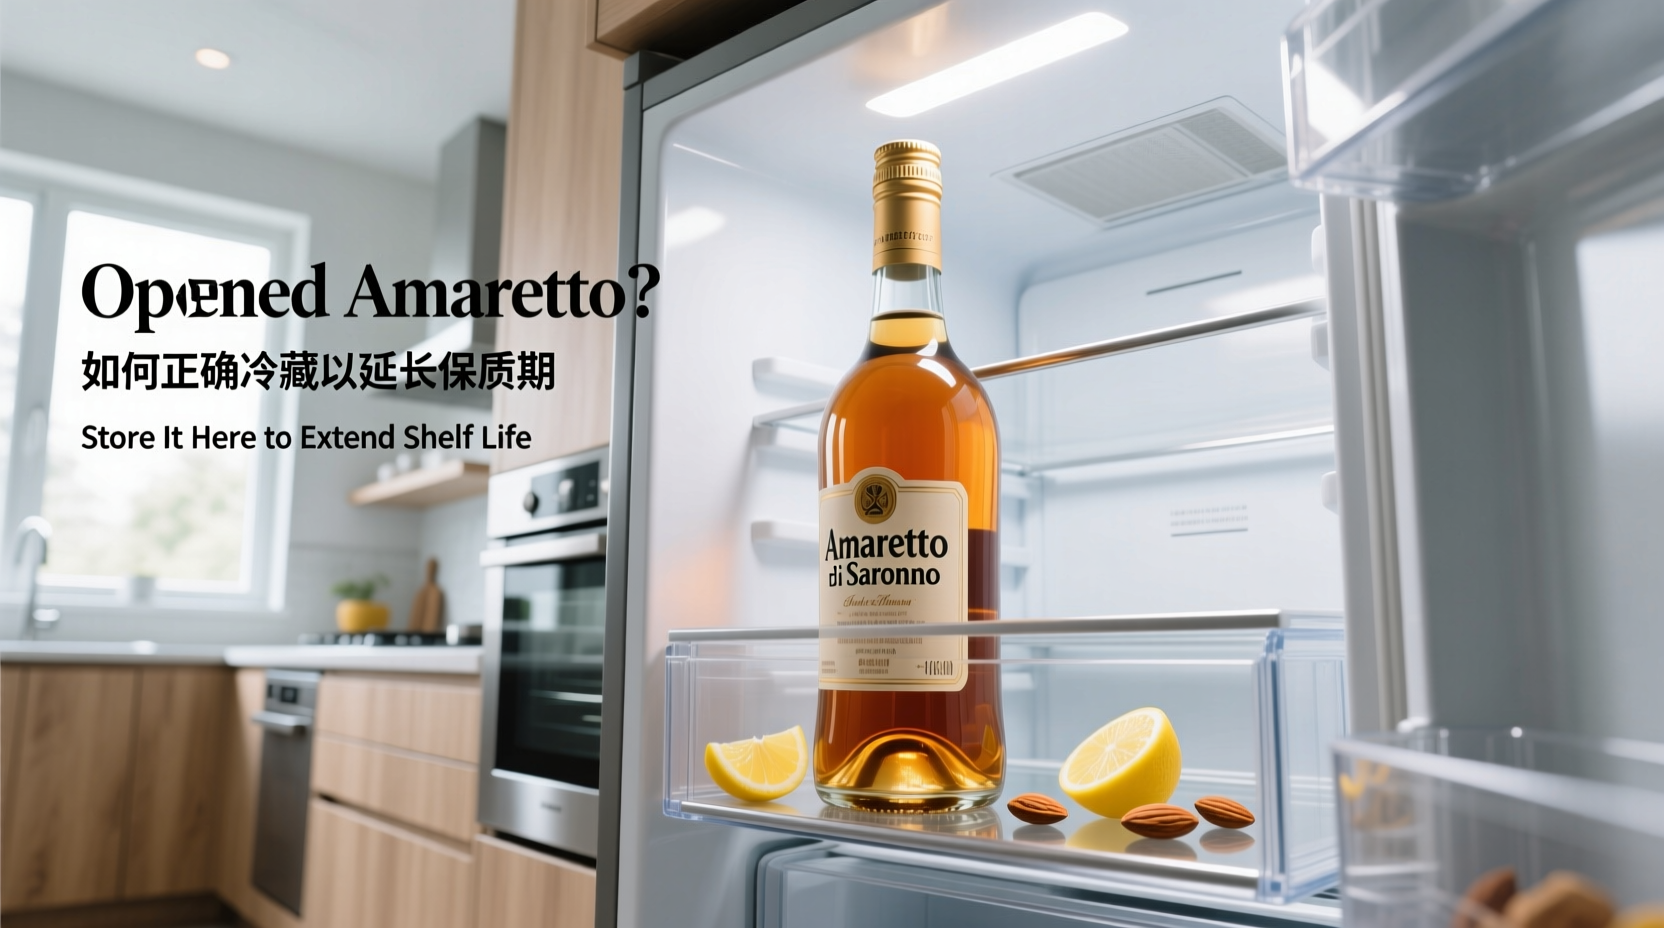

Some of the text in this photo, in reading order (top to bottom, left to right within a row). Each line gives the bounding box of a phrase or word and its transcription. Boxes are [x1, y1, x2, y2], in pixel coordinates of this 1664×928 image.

[825, 528, 948, 562] Amaretto
[828, 561, 941, 587] di Saronno
